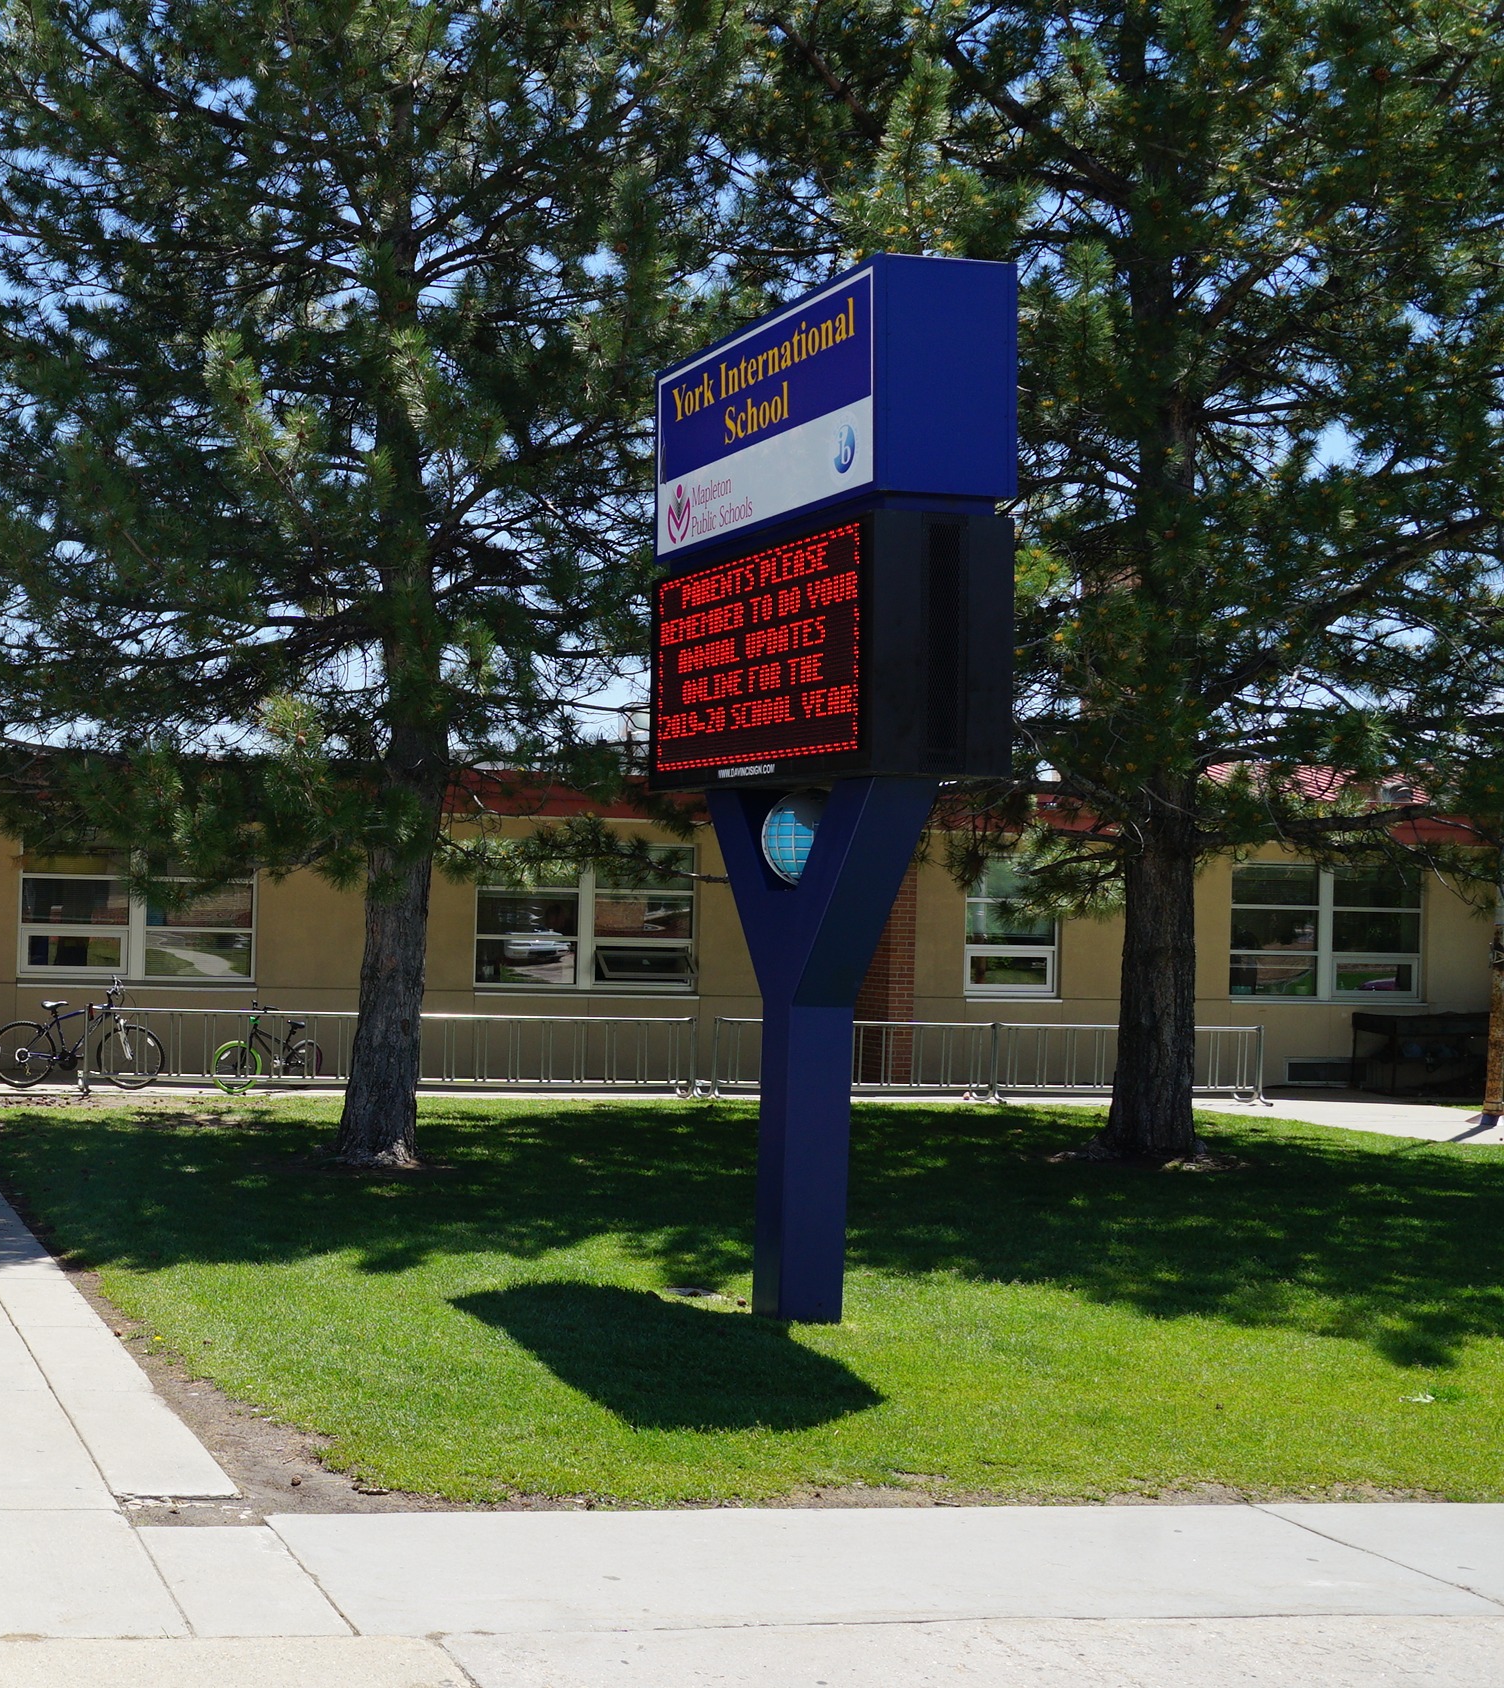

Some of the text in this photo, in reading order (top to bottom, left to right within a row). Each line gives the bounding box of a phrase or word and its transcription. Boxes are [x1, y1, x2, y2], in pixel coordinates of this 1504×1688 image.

[672, 297, 856, 422] York International
[724, 381, 789, 445] School
[691, 478, 732, 509] Mapleton
[691, 496, 753, 537] Public Schools
[682, 541, 829, 609] PARENTS PLEASE
[660, 570, 858, 647] REMEMBER TO DO YOUR
[678, 616, 826, 674] ANNUAL UPDATES
[682, 653, 824, 705] ONLINE FOR THE
[659, 685, 853, 740] 2019-20 SCHOOL YEAR
[718, 763, 776, 778] WWW.DAVINCISIGN.COM
